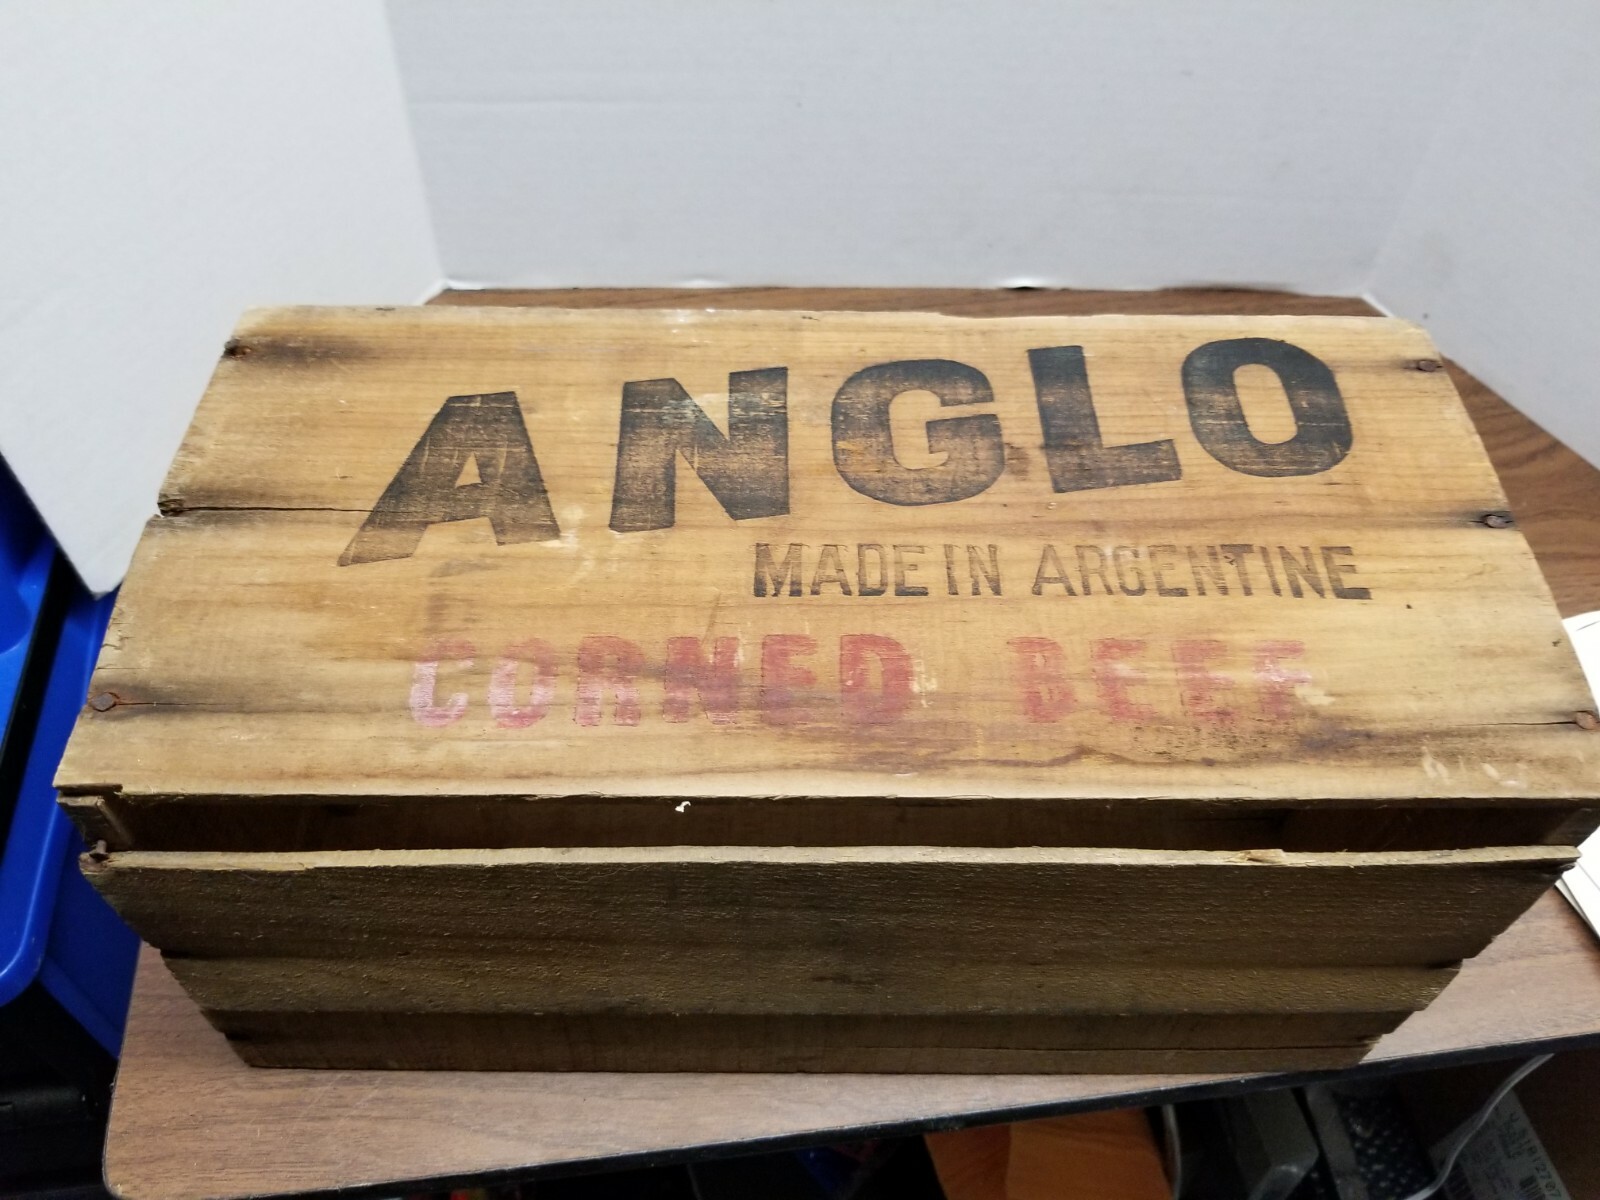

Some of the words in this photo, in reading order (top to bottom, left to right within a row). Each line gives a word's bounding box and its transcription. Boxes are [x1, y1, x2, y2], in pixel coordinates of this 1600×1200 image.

[338, 337, 1353, 567] ANGLO
[754, 542, 929, 597] MADE
[943, 543, 1001, 597] IN
[1031, 544, 1372, 600] ARGENTINE
[408, 633, 915, 728] CORNED
[1008, 636, 1308, 725] BEEF
